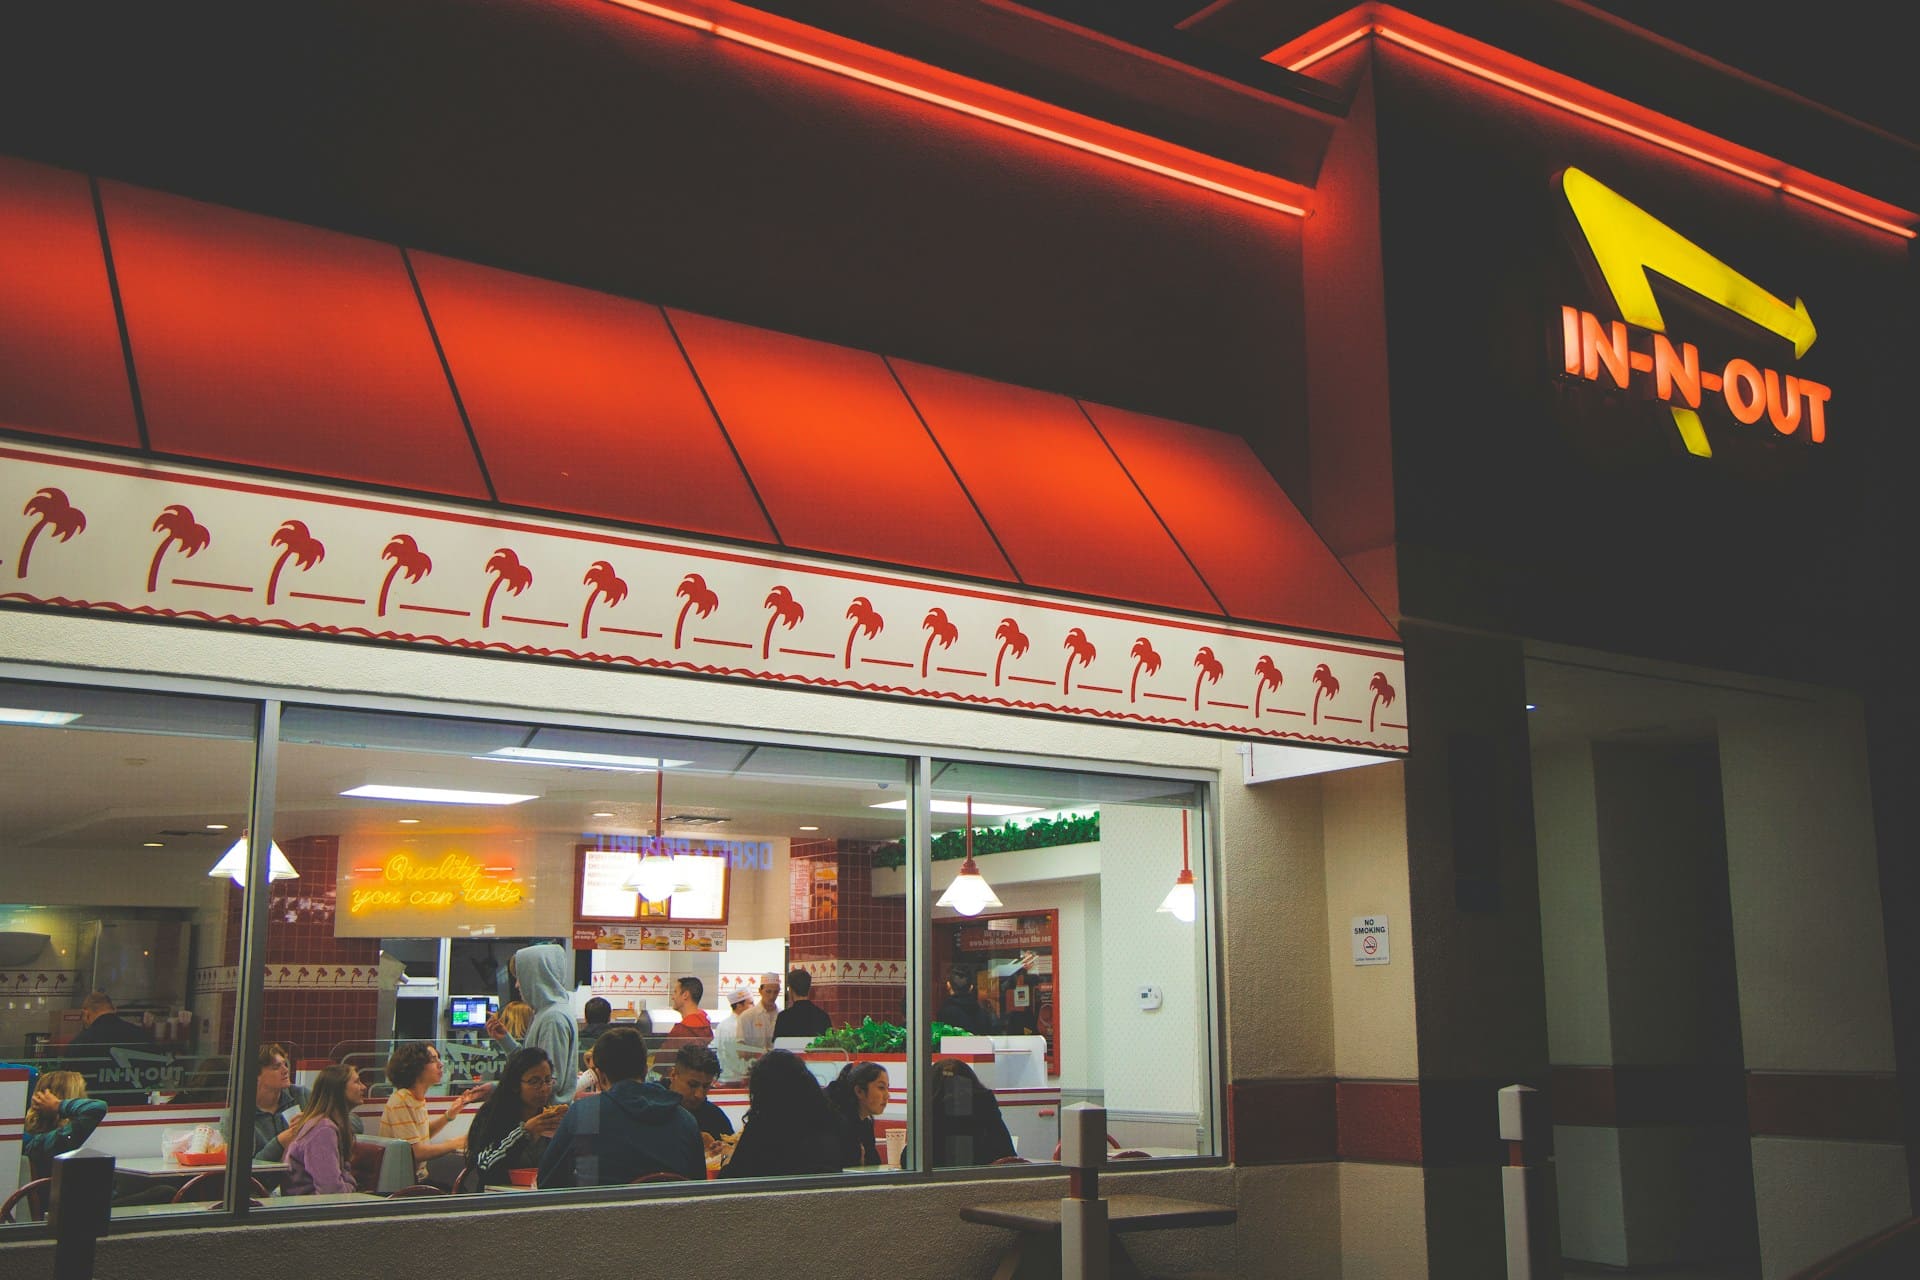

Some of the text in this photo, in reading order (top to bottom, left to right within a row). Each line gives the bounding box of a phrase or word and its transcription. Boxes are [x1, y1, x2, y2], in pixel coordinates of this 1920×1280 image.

[1562, 305, 1831, 443] IN-N-OUT
[386, 854, 482, 887] Quality
[352, 880, 521, 912] you can taste
[1354, 926, 1386, 934] SMOKING
